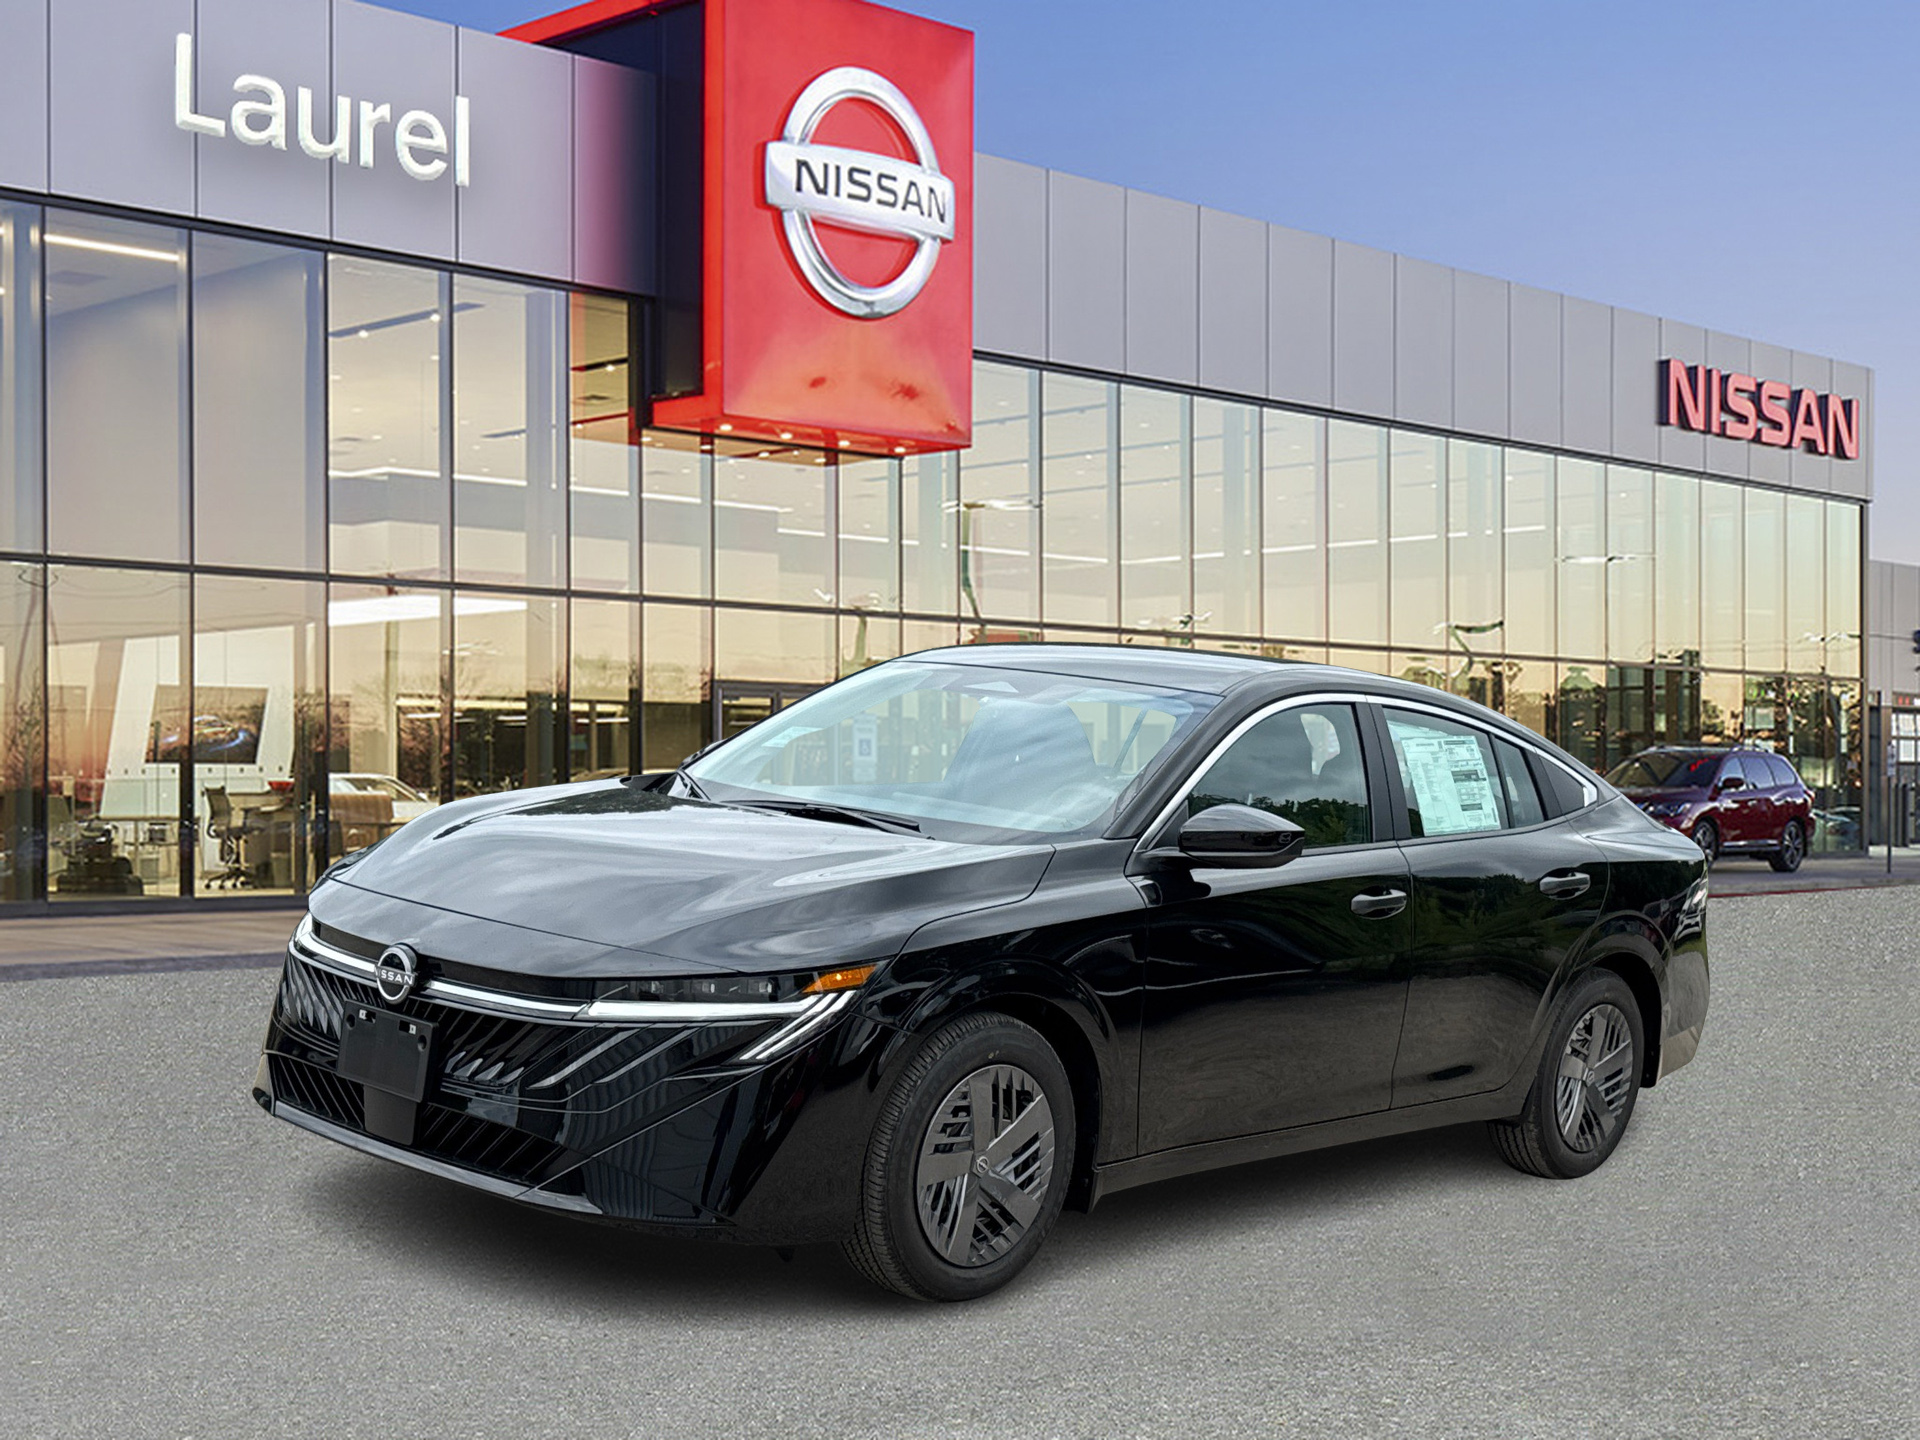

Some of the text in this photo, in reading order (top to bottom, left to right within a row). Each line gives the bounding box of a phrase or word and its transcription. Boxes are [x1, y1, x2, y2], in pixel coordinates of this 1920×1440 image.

[175, 32, 471, 188] Laurel
[794, 158, 947, 224] NISSAN
[1660, 357, 1860, 460] NISSAN
